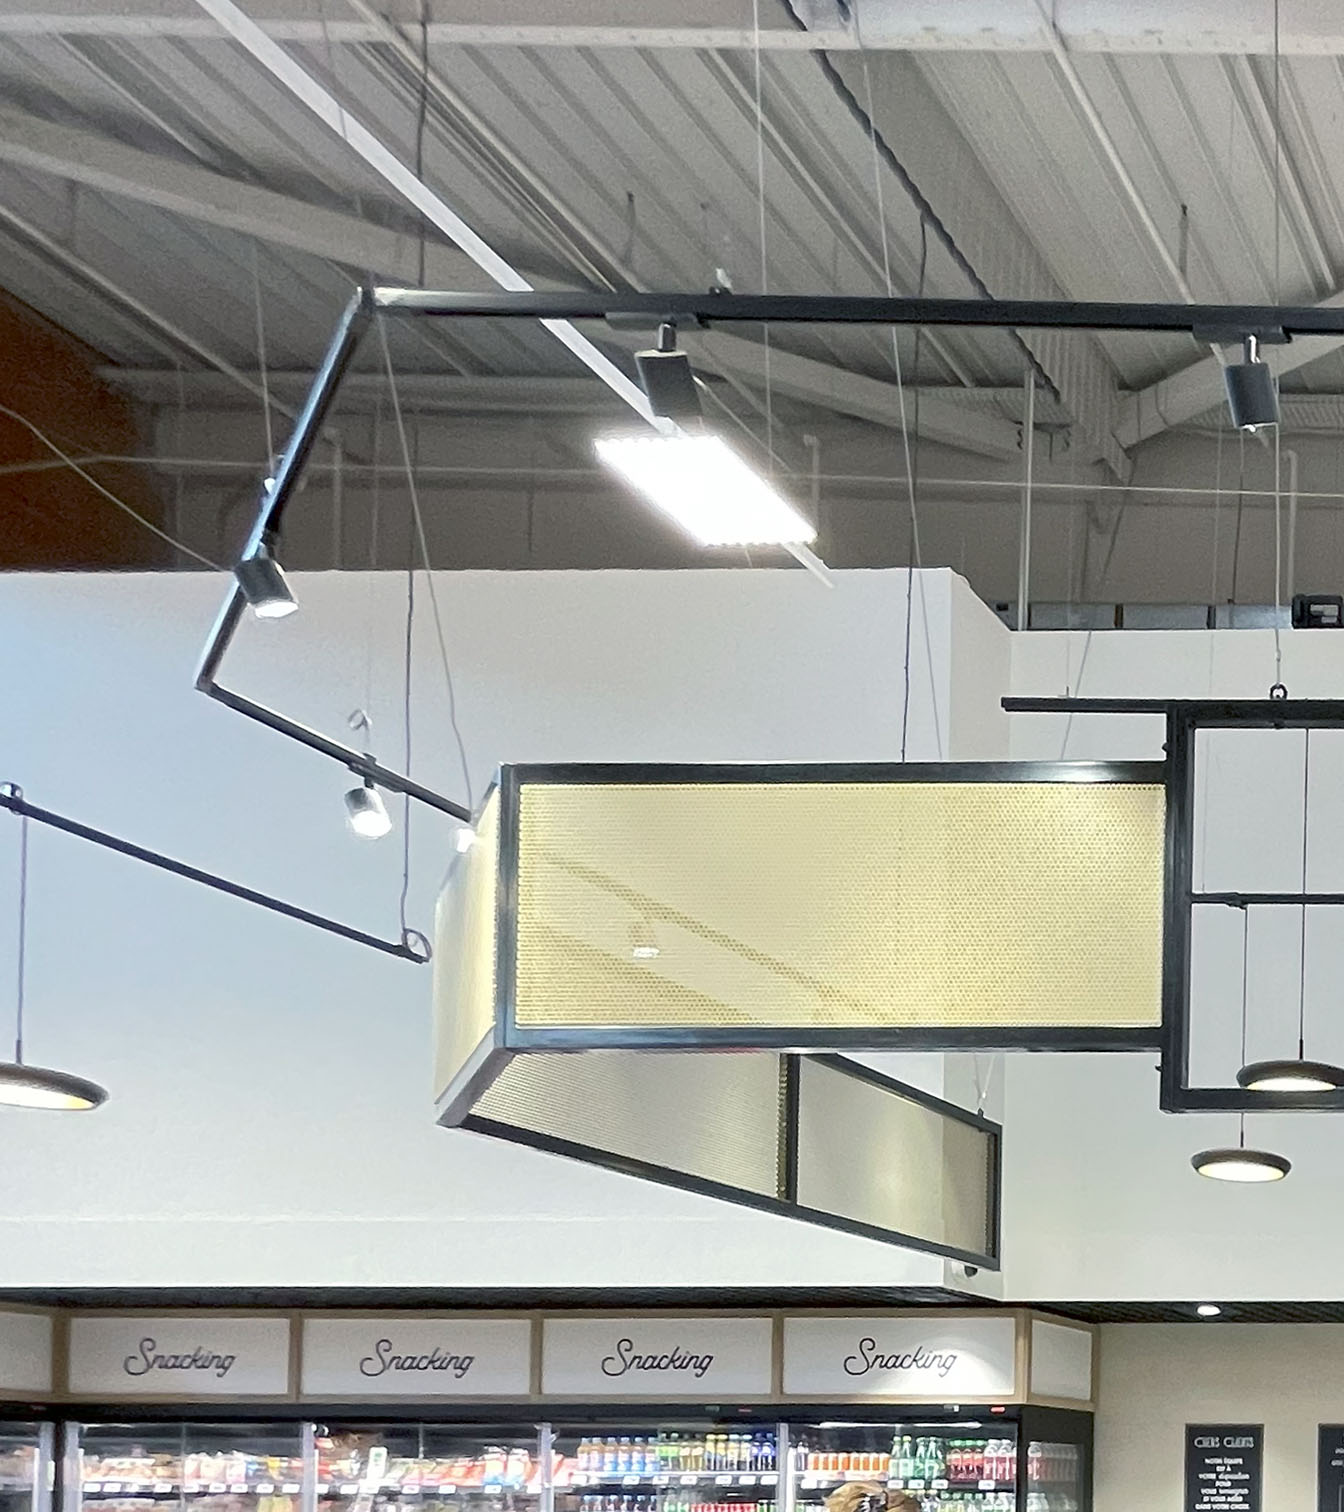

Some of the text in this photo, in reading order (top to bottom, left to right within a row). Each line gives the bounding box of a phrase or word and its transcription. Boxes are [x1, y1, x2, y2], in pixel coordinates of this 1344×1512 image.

[123, 1338, 236, 1378] Snacking
[360, 1338, 475, 1378] Snacking
[601, 1338, 714, 1378] Snacking
[844, 1337, 958, 1376] Snacking
